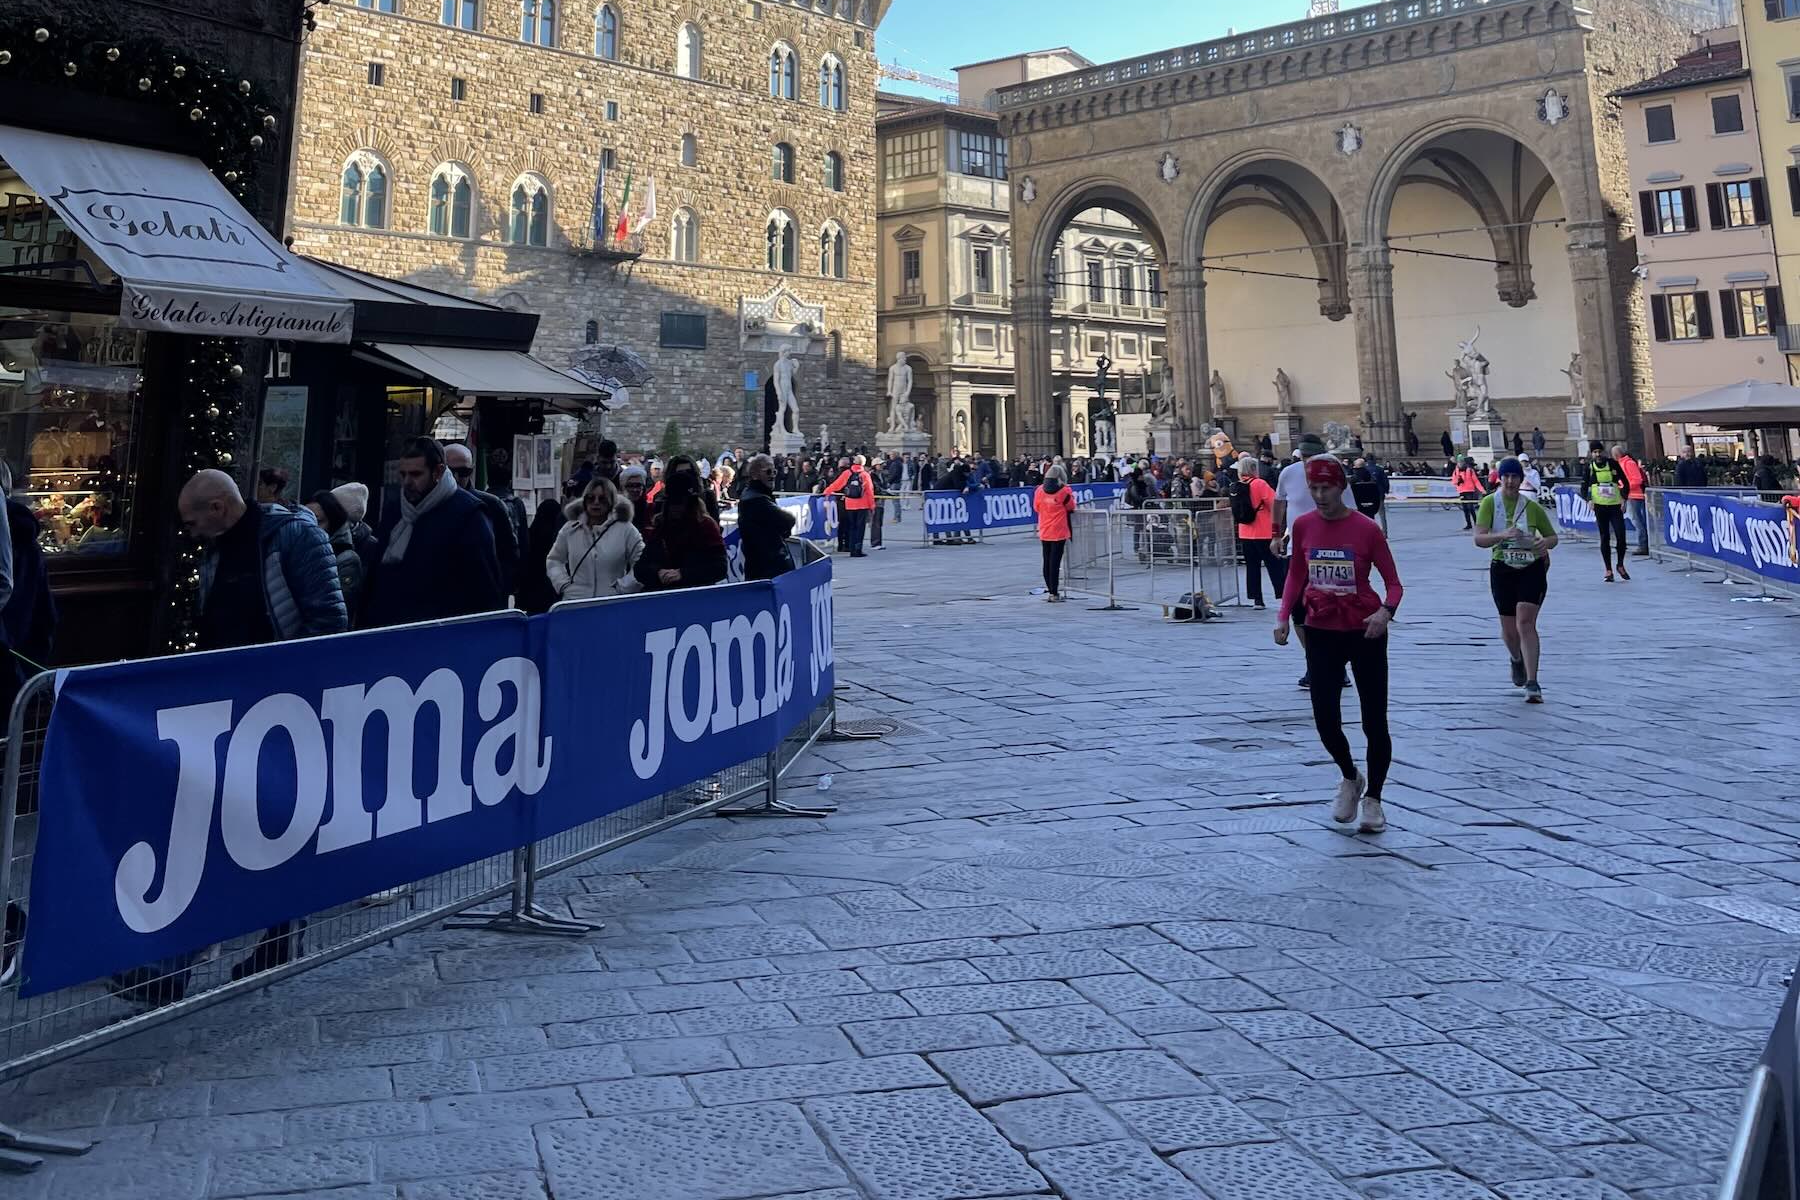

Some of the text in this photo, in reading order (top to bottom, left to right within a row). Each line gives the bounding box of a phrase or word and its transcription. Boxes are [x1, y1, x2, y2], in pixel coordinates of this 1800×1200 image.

[87, 201, 245, 246] Gelati
[132, 294, 345, 336] Gelato Artigianale
[925, 491, 1032, 526] oma Joma
[1316, 565, 1348, 580] F1743
[629, 603, 795, 780] Joma
[115, 656, 552, 934] Joma
